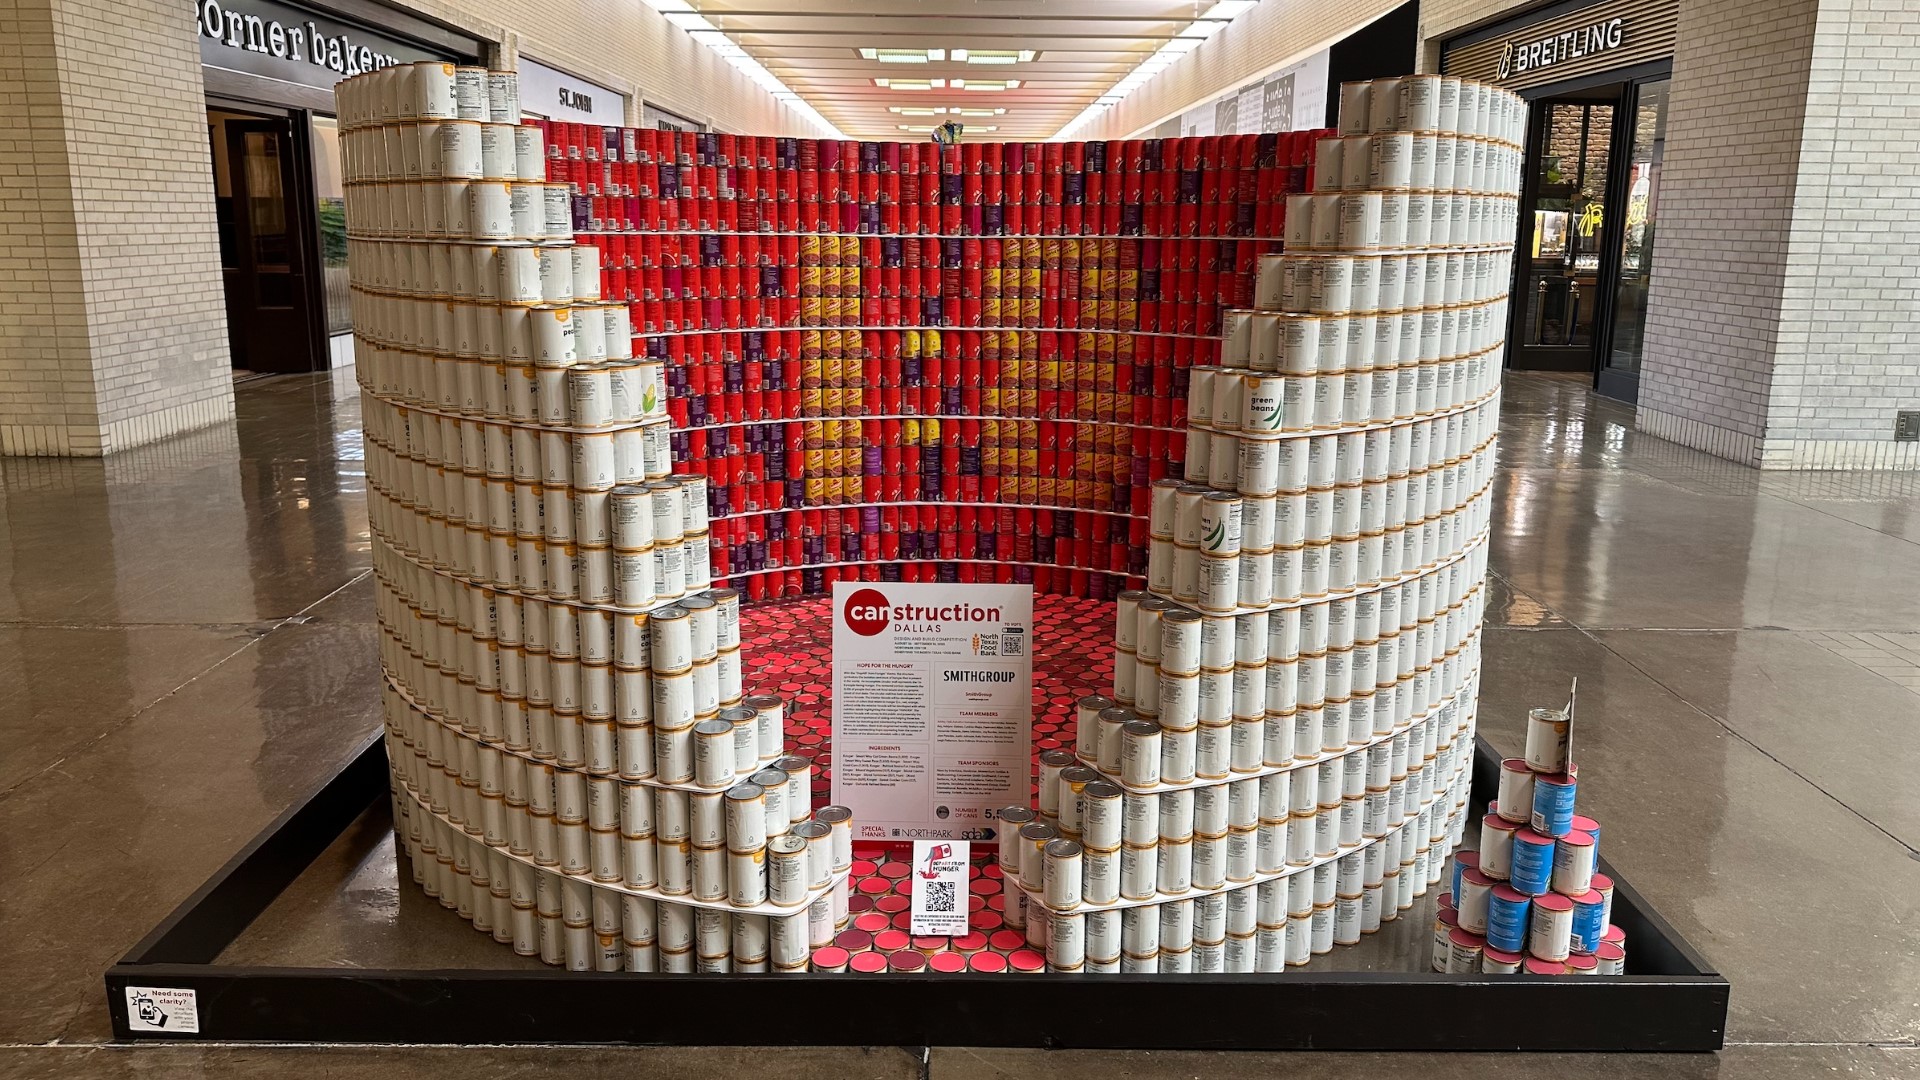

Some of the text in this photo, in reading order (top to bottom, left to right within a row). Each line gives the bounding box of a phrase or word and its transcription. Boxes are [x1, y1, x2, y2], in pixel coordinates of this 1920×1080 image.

[1517, 18, 1622, 72] BREITLING
[851, 603, 1000, 622] canstruction
[894, 624, 941, 633] DALLAS
[943, 670, 1015, 682] SMITHGROUP
[902, 829, 952, 838] NORTHPARK
[961, 828, 982, 840] sda
[159, 998, 187, 1006] clarity?
